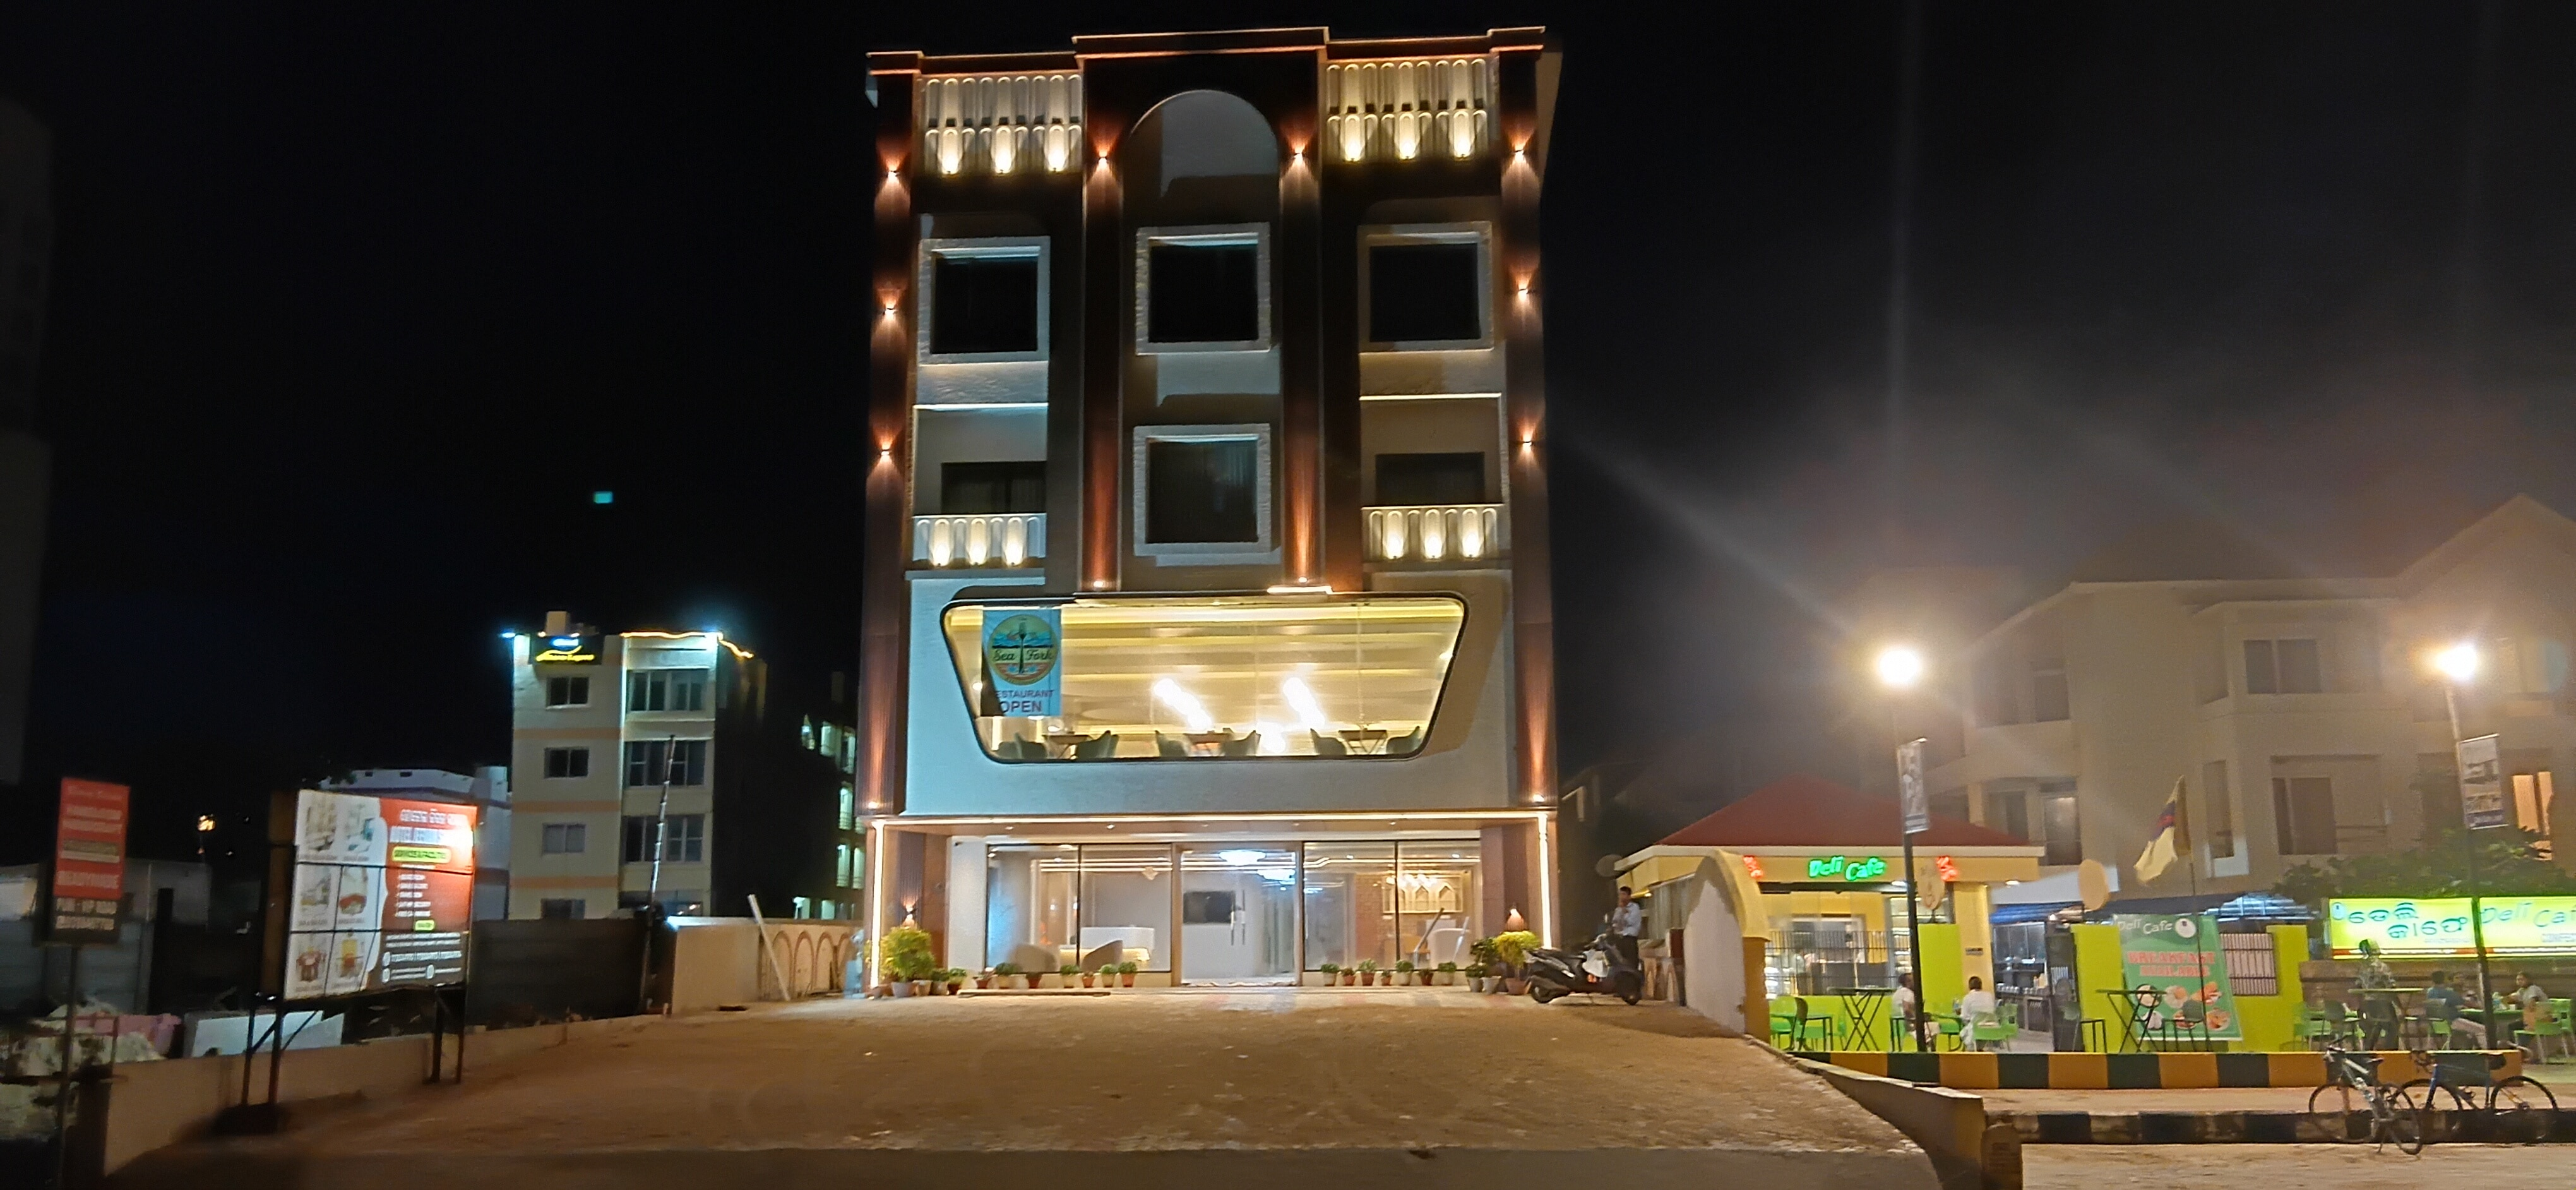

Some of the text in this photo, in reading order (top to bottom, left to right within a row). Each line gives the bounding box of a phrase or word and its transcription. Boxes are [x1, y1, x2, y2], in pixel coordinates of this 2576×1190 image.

[993, 649, 1053, 661] Sea Fork
[995, 690, 1054, 699] ESTAURANT
[999, 700, 1042, 713] OPEN
[1809, 856, 1887, 880] Deli Cafe
[2480, 901, 2576, 928] Deli Caf
[2118, 919, 2173, 935] Deli Cafe
